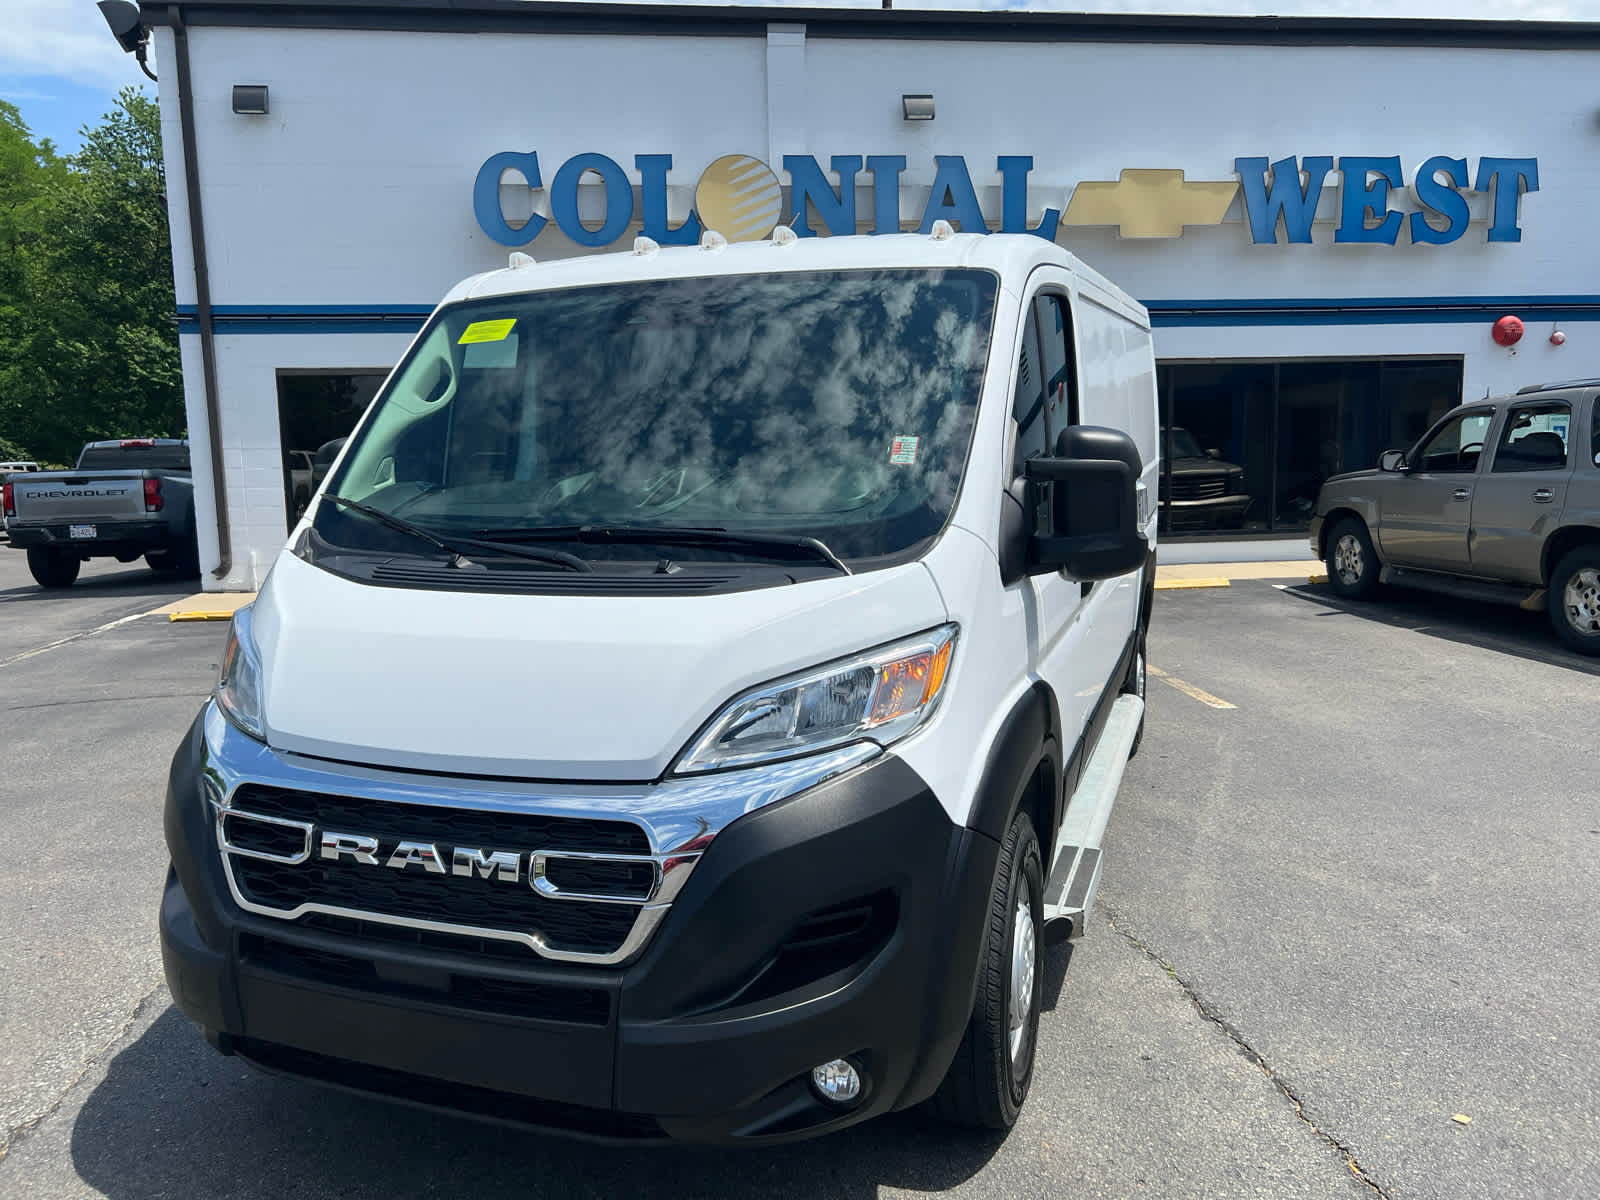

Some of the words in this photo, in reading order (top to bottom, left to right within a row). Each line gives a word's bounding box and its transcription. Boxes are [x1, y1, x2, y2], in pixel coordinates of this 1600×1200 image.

[473, 151, 1060, 247] COLONIAL
[1234, 155, 1539, 246] WEST
[26, 489, 129, 499] CHEVROLET
[321, 831, 521, 882] RAM
